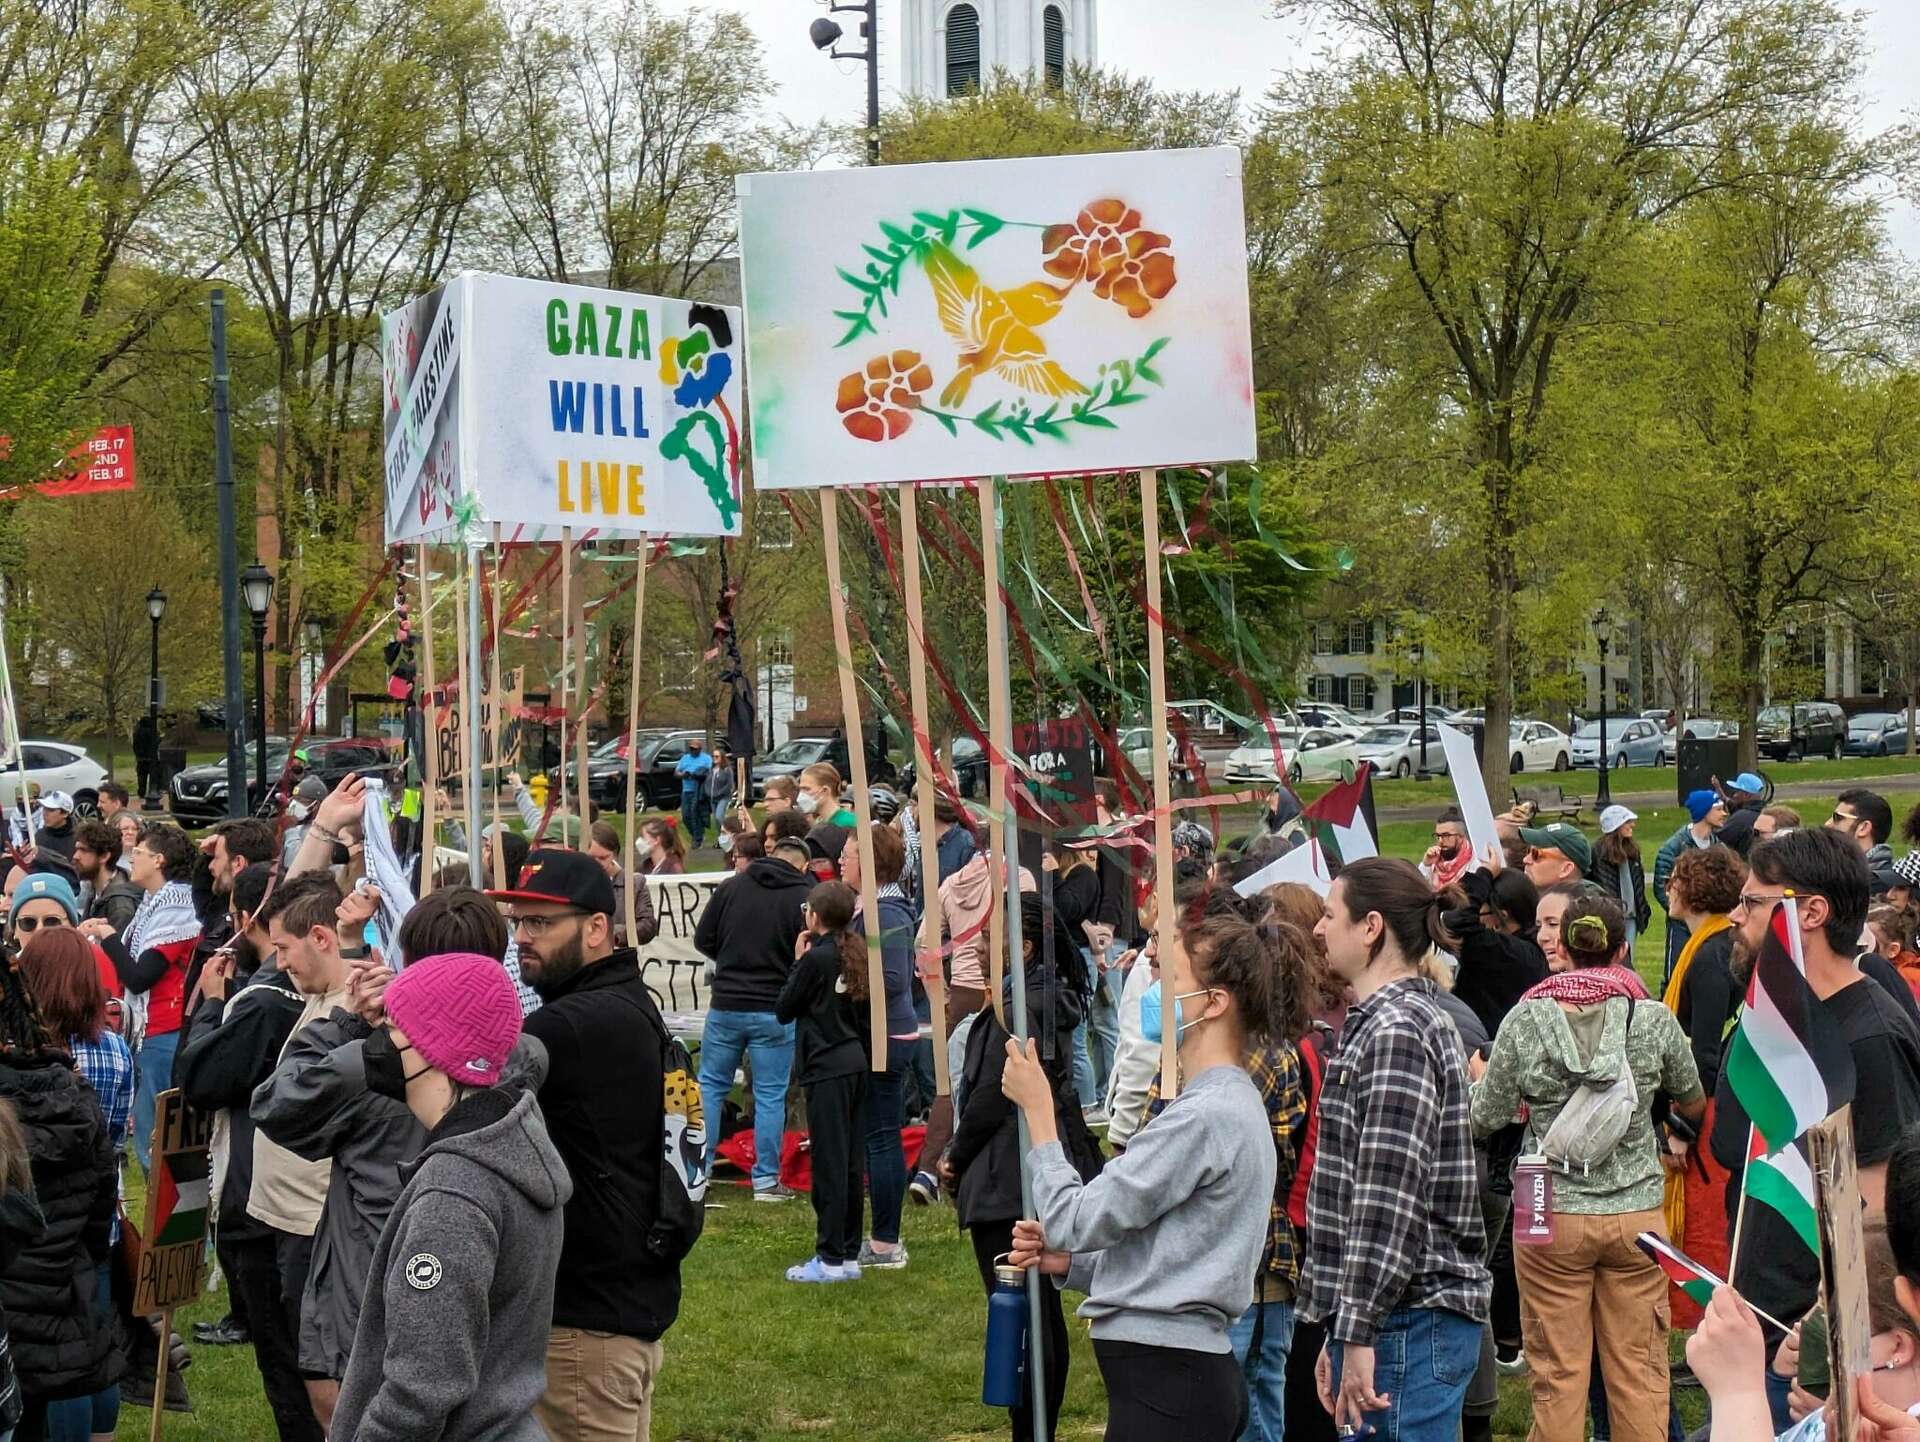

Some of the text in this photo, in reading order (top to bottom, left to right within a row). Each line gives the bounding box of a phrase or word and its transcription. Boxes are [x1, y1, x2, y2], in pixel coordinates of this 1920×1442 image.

[546, 299, 650, 360] GAZA
[549, 380, 649, 438] WILL
[88, 438, 125, 452] FEB. 17
[88, 467, 124, 480] FEB. 18
[558, 459, 645, 516] LIVE
[1029, 751, 1067, 771] FOR A
[1534, 1174, 1545, 1212] HAZEN
